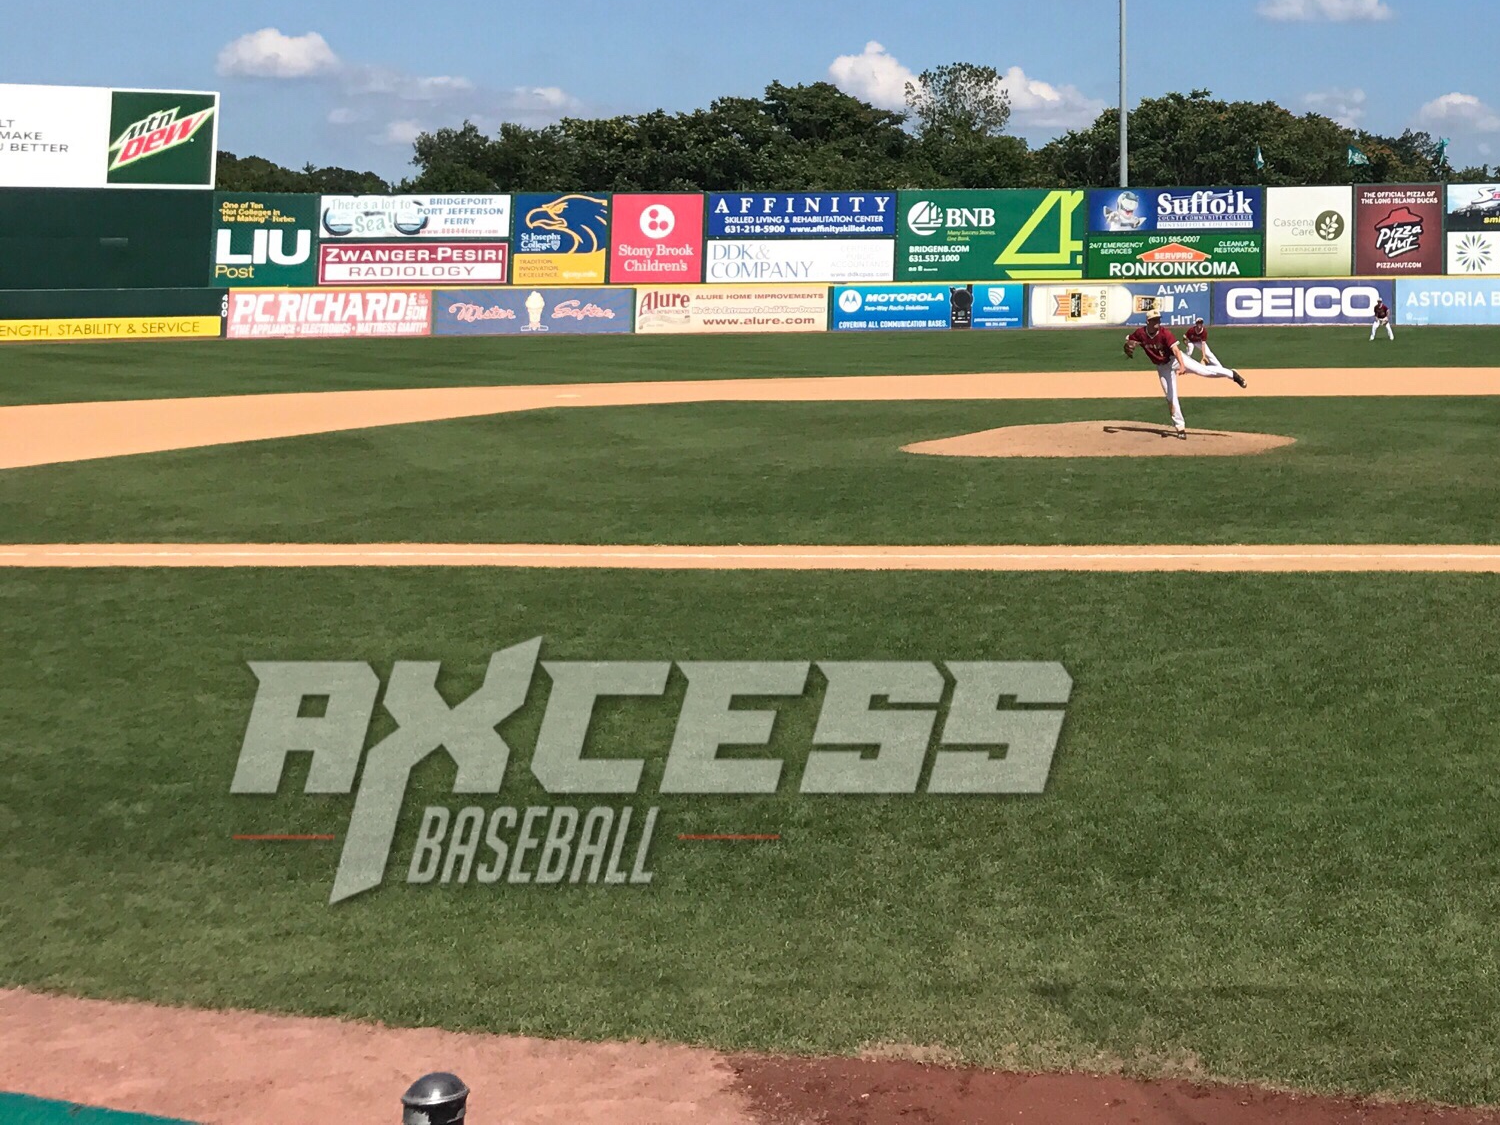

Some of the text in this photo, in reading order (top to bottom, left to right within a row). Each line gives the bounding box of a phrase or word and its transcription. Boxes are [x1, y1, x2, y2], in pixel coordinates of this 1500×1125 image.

[11, 143, 69, 153] BETTER
[371, 201, 378, 209] a
[381, 198, 396, 210] lot
[400, 199, 411, 210] to
[714, 196, 890, 213] AFFINITY
[1157, 189, 1254, 215] Suffolk
[355, 212, 393, 233] Sea!
[724, 216, 755, 224] SKILLED
[756, 216, 782, 224] LIVING
[792, 215, 853, 223] REHABILITATION
[854, 215, 884, 223] CENTER
[945, 208, 996, 227] BNB
[1273, 218, 1315, 227] Cassena
[724, 225, 884, 235] 631-218-5900 www.affinityskilled.com
[1291, 227, 1315, 236] Care
[1376, 222, 1422, 249] Pizza
[215, 228, 311, 266] LIU
[521, 240, 551, 251] College
[1148, 236, 1168, 245] (631)
[1384, 235, 1418, 254] Hut
[325, 246, 503, 262] ZWANGER-PESIRI
[618, 244, 694, 259] Stony Brook
[909, 245, 970, 253] BRIDGENB.COM
[908, 254, 960, 262] 631.537.1000
[1154, 252, 1193, 260] SERVPRO
[624, 259, 688, 272] Children's
[711, 261, 814, 279] COMPANY
[830, 260, 890, 268] ACCOUNTANTS
[1109, 261, 1241, 276] RONKONKOMA
[215, 265, 254, 278] Post
[349, 266, 476, 277] RADIOLOGY
[1156, 282, 1209, 295] ALWAYS
[638, 291, 690, 317] Alure
[865, 293, 945, 302] MOTOROLA
[1177, 298, 1189, 310] A
[1226, 286, 1380, 318] GEICO
[1406, 291, 1486, 307] ASTORIA
[277, 291, 408, 322] RICHARD
[1099, 289, 1107, 320] GEORGI
[404, 305, 429, 321] SON
[449, 302, 516, 323] Mister
[703, 317, 815, 325] www.alure.com
[838, 319, 948, 329] COVERING ALL COMMUNICATION BASES.
[1170, 313, 1196, 326] HIT!
[58, 323, 122, 336] STABILITY
[126, 323, 137, 334] &
[141, 321, 200, 334] SERVICE
[251, 322, 397, 335] APPLIANCE ELECTRONICS MATTRESS
